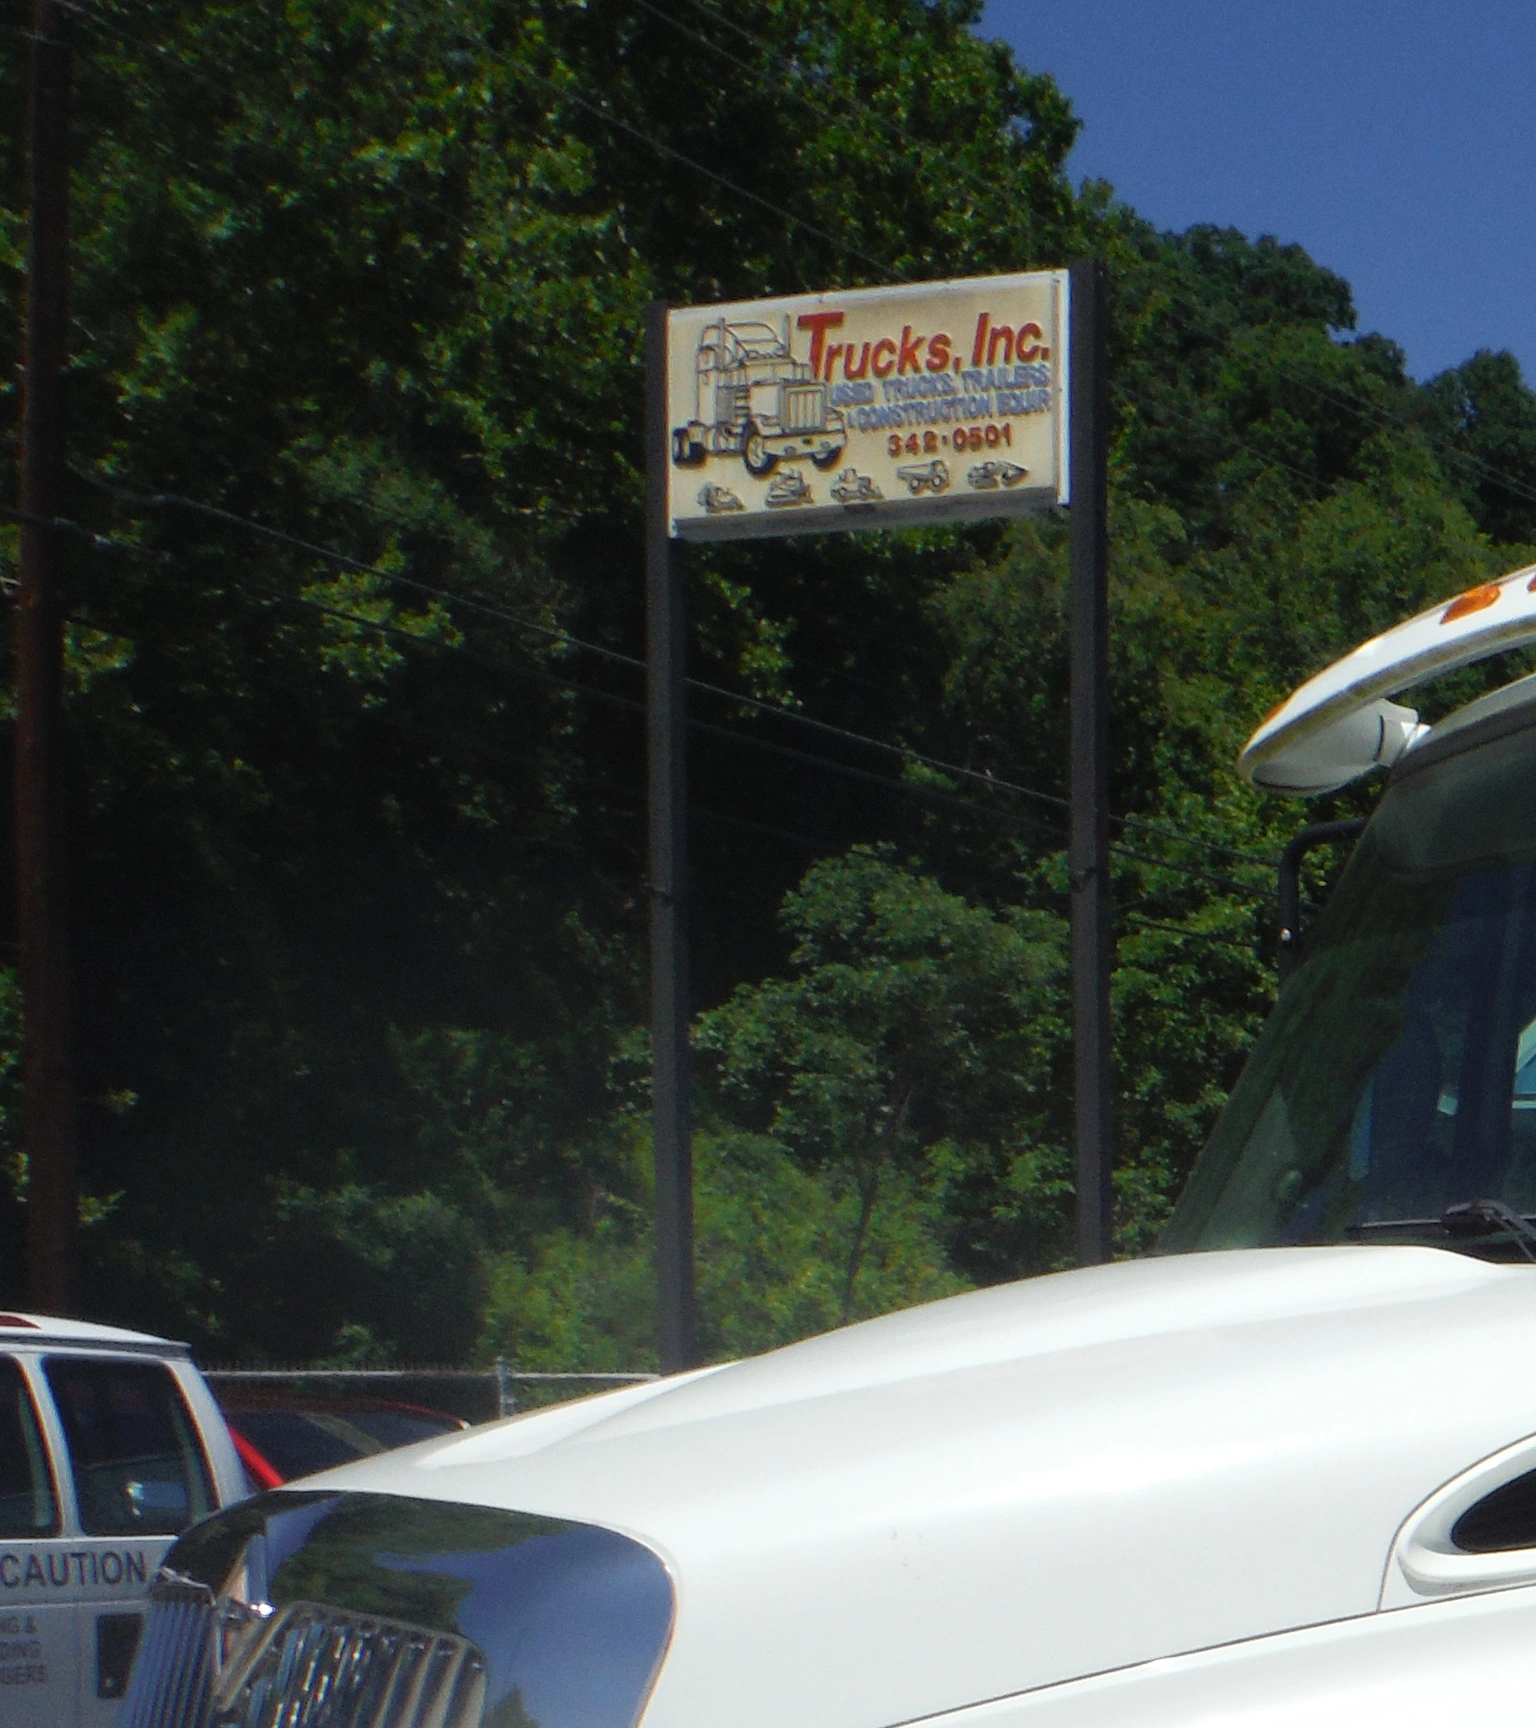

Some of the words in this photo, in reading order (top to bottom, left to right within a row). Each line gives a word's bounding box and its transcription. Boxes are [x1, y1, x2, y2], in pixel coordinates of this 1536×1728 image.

[798, 312, 962, 382] Trucks,
[971, 312, 1050, 367] Inc.
[0, 1551, 147, 1588] CAUTION
